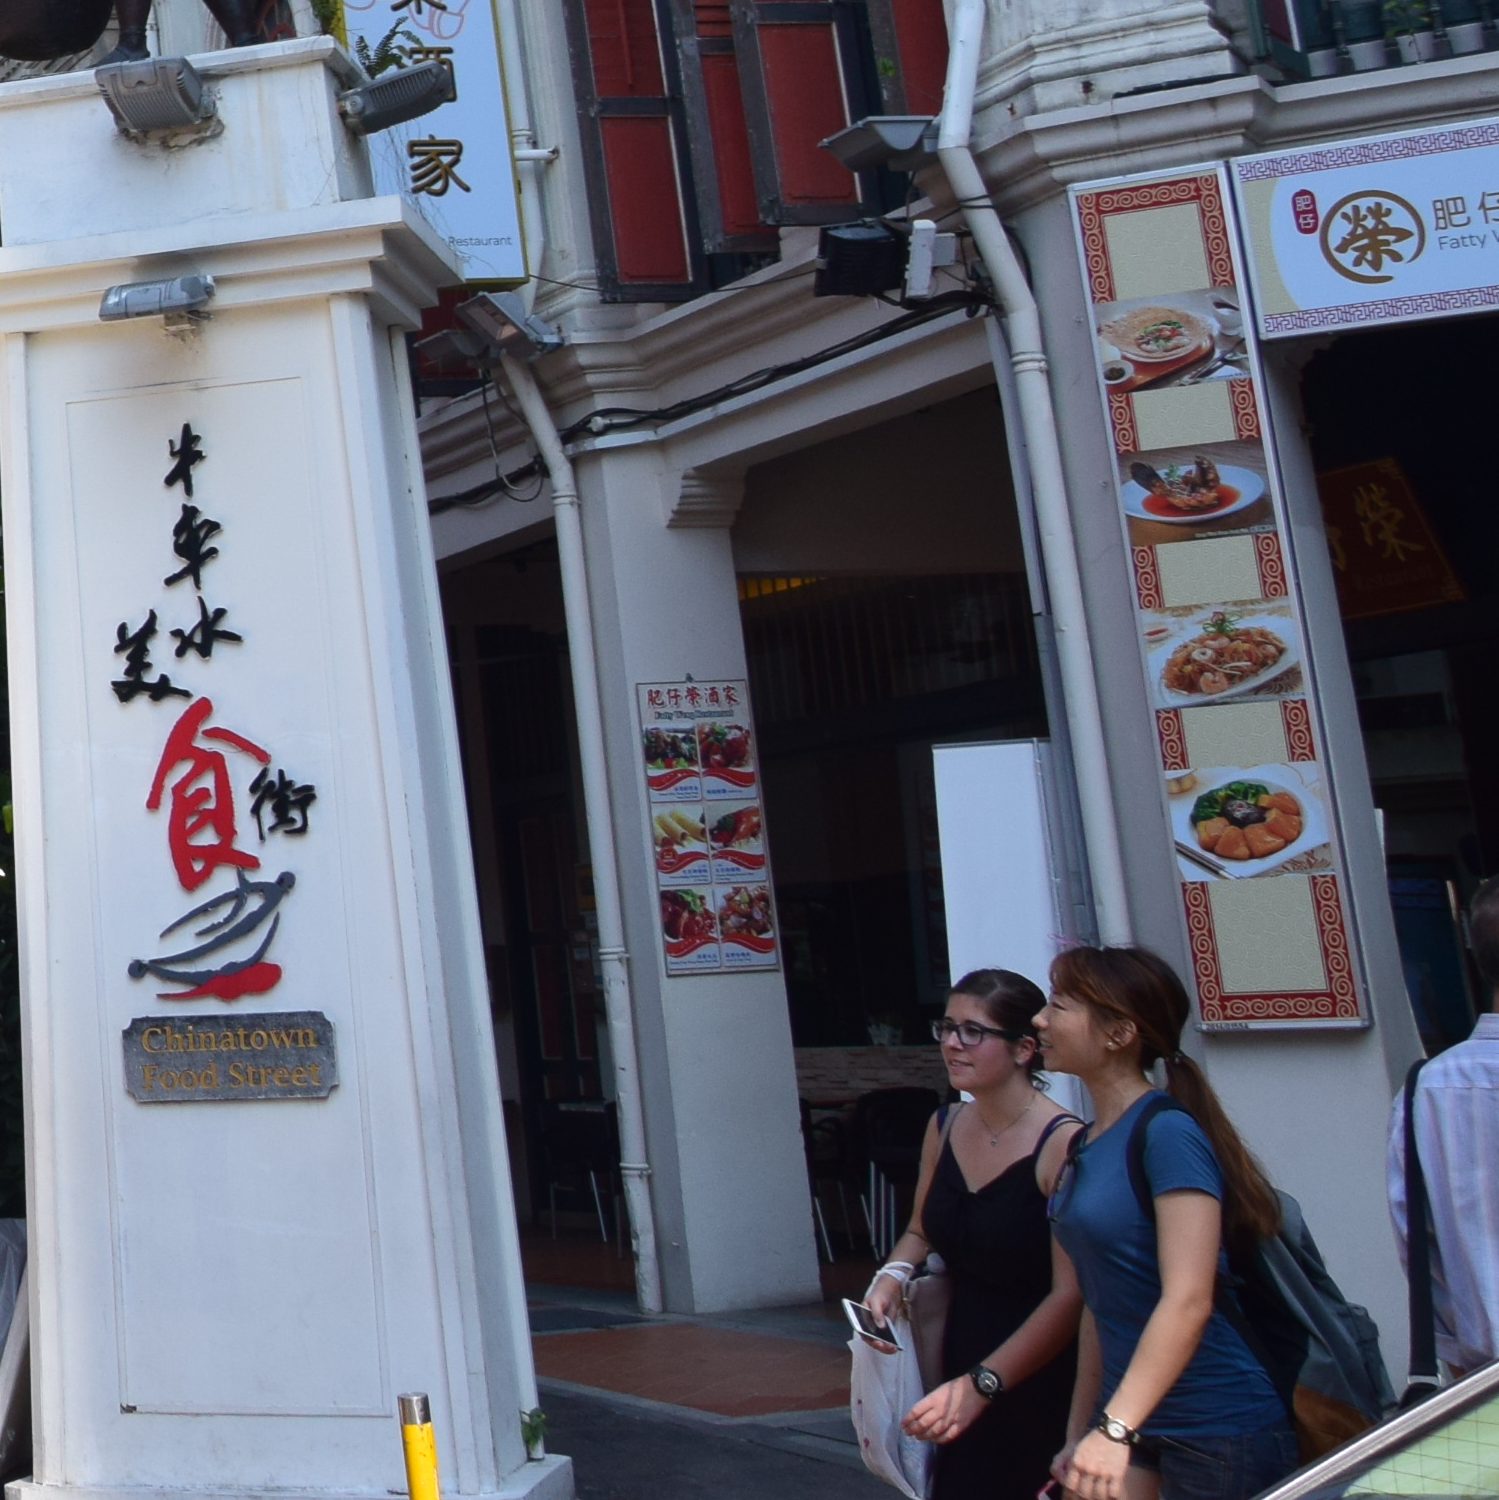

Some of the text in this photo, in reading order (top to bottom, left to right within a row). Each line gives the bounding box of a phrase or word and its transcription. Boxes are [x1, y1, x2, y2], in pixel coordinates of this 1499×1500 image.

[448, 236, 512, 247] Restaurant
[1438, 233, 1487, 251] Fatty
[141, 1025, 318, 1054] Chinatown
[141, 1058, 323, 1092] Food Street
